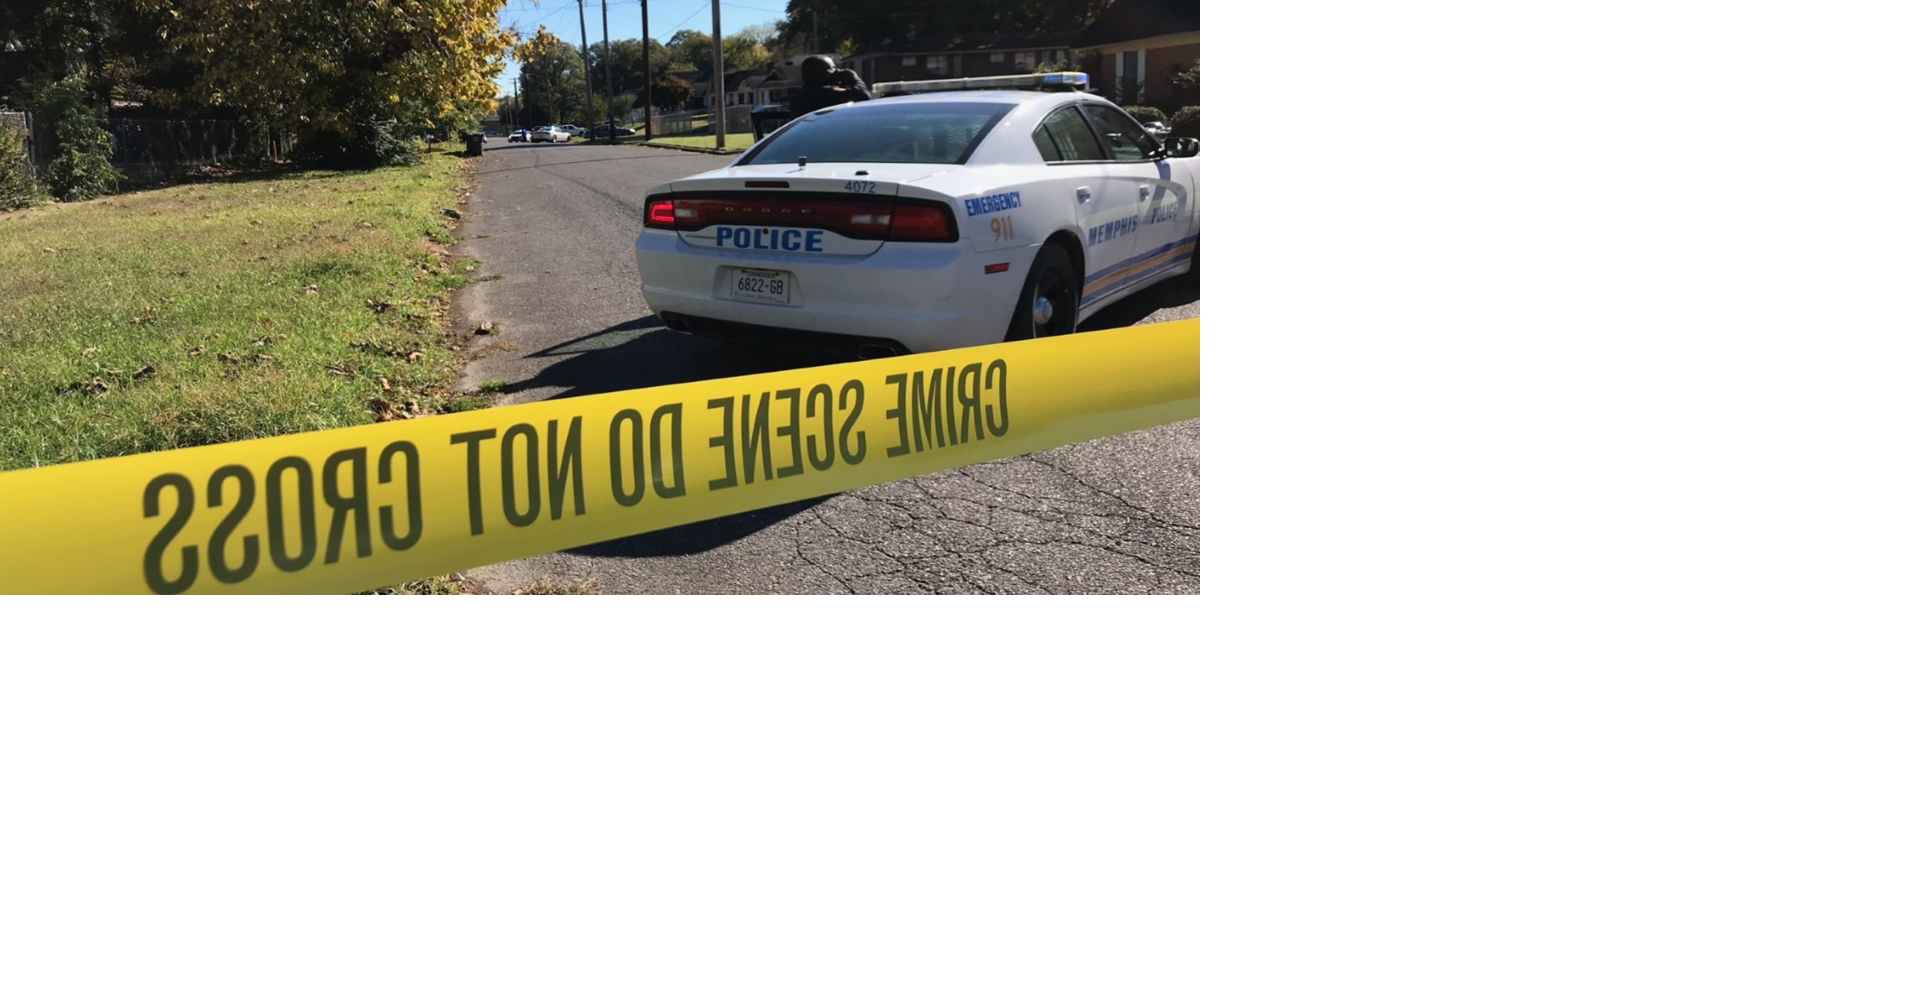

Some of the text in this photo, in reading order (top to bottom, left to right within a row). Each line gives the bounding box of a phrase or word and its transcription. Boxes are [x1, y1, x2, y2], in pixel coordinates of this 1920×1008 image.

[844, 181, 877, 194] 4072
[725, 206, 811, 214] DODGE
[965, 191, 1022, 217] EMERGENCY
[716, 226, 824, 252] POLICE
[990, 216, 1014, 243] 911
[1088, 215, 1139, 248] MEMPHIS
[738, 277, 783, 295] 6822-GB
